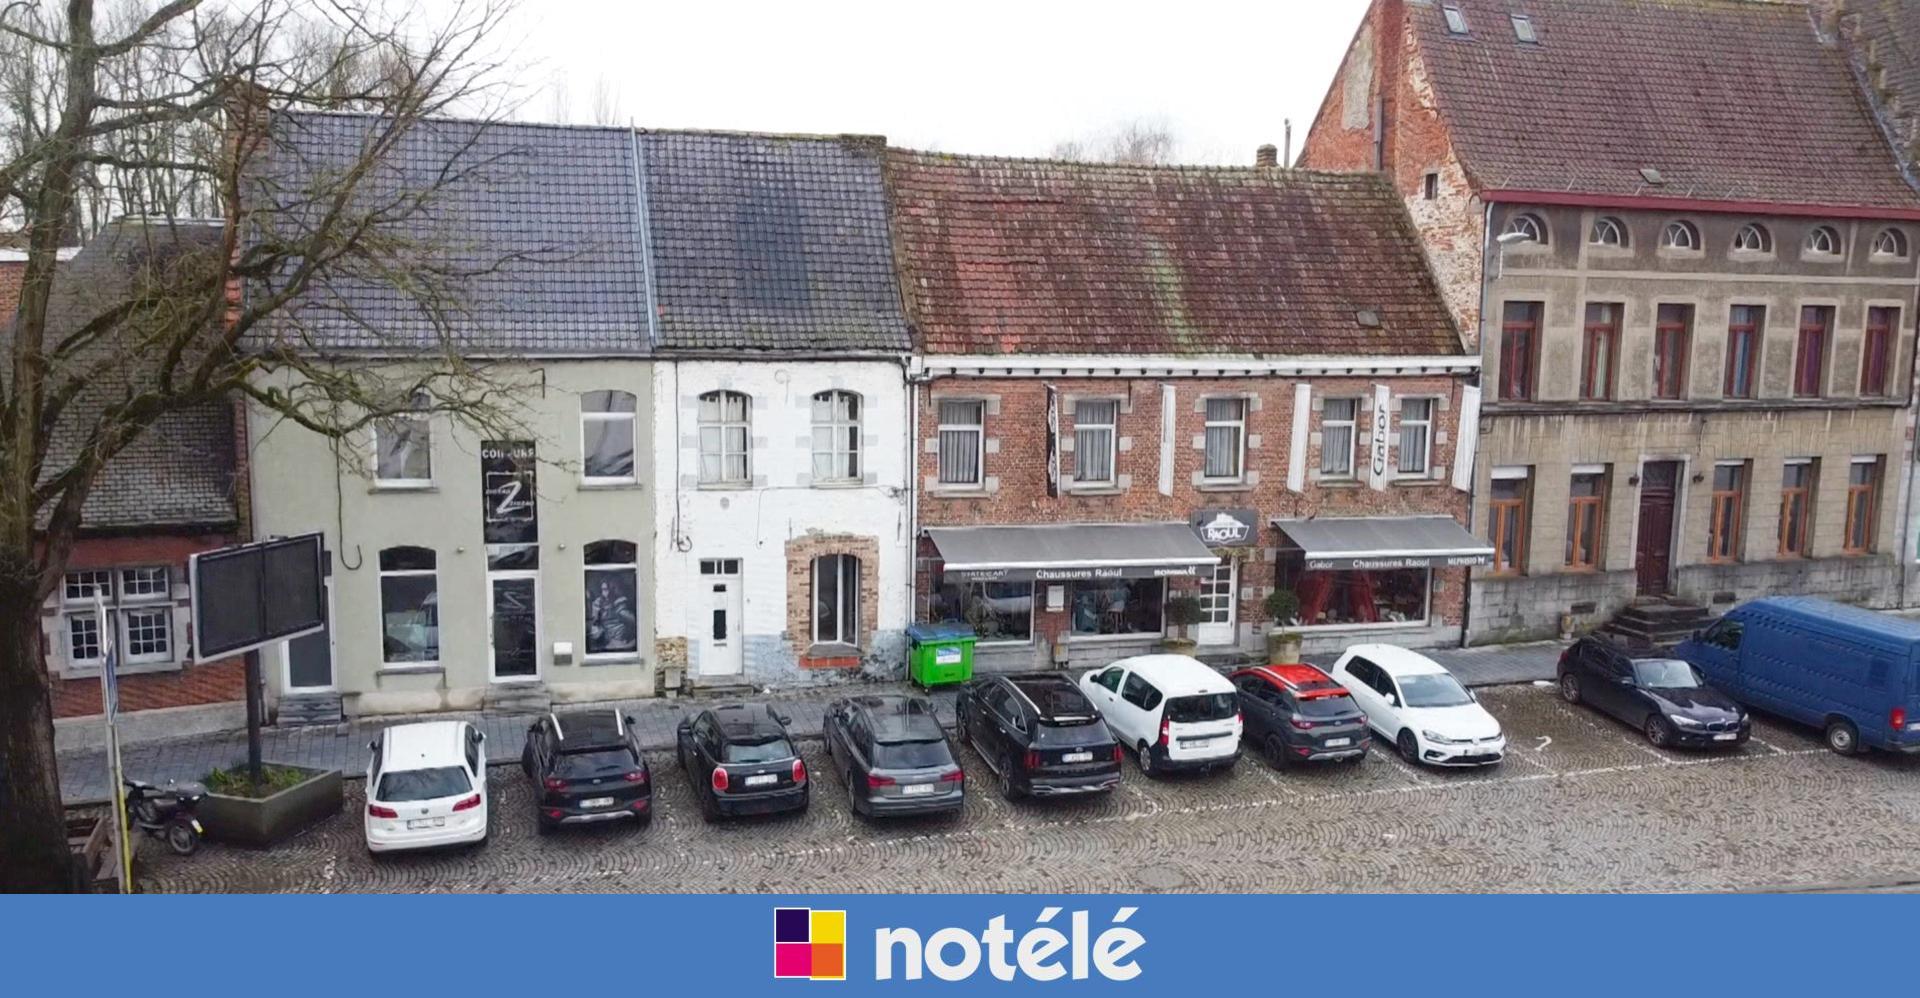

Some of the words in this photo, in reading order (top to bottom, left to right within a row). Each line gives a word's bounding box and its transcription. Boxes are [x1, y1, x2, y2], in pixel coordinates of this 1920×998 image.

[1373, 404, 1386, 476] Gabor
[482, 448, 534, 459] COIURE
[1207, 527, 1242, 540] RAOUL
[1309, 559, 1333, 569] Gabor
[1352, 559, 1403, 569] Chaussures
[1406, 557, 1430, 567] Raoul
[1036, 569, 1092, 579] Chaussures
[1095, 567, 1122, 577] Raoul
